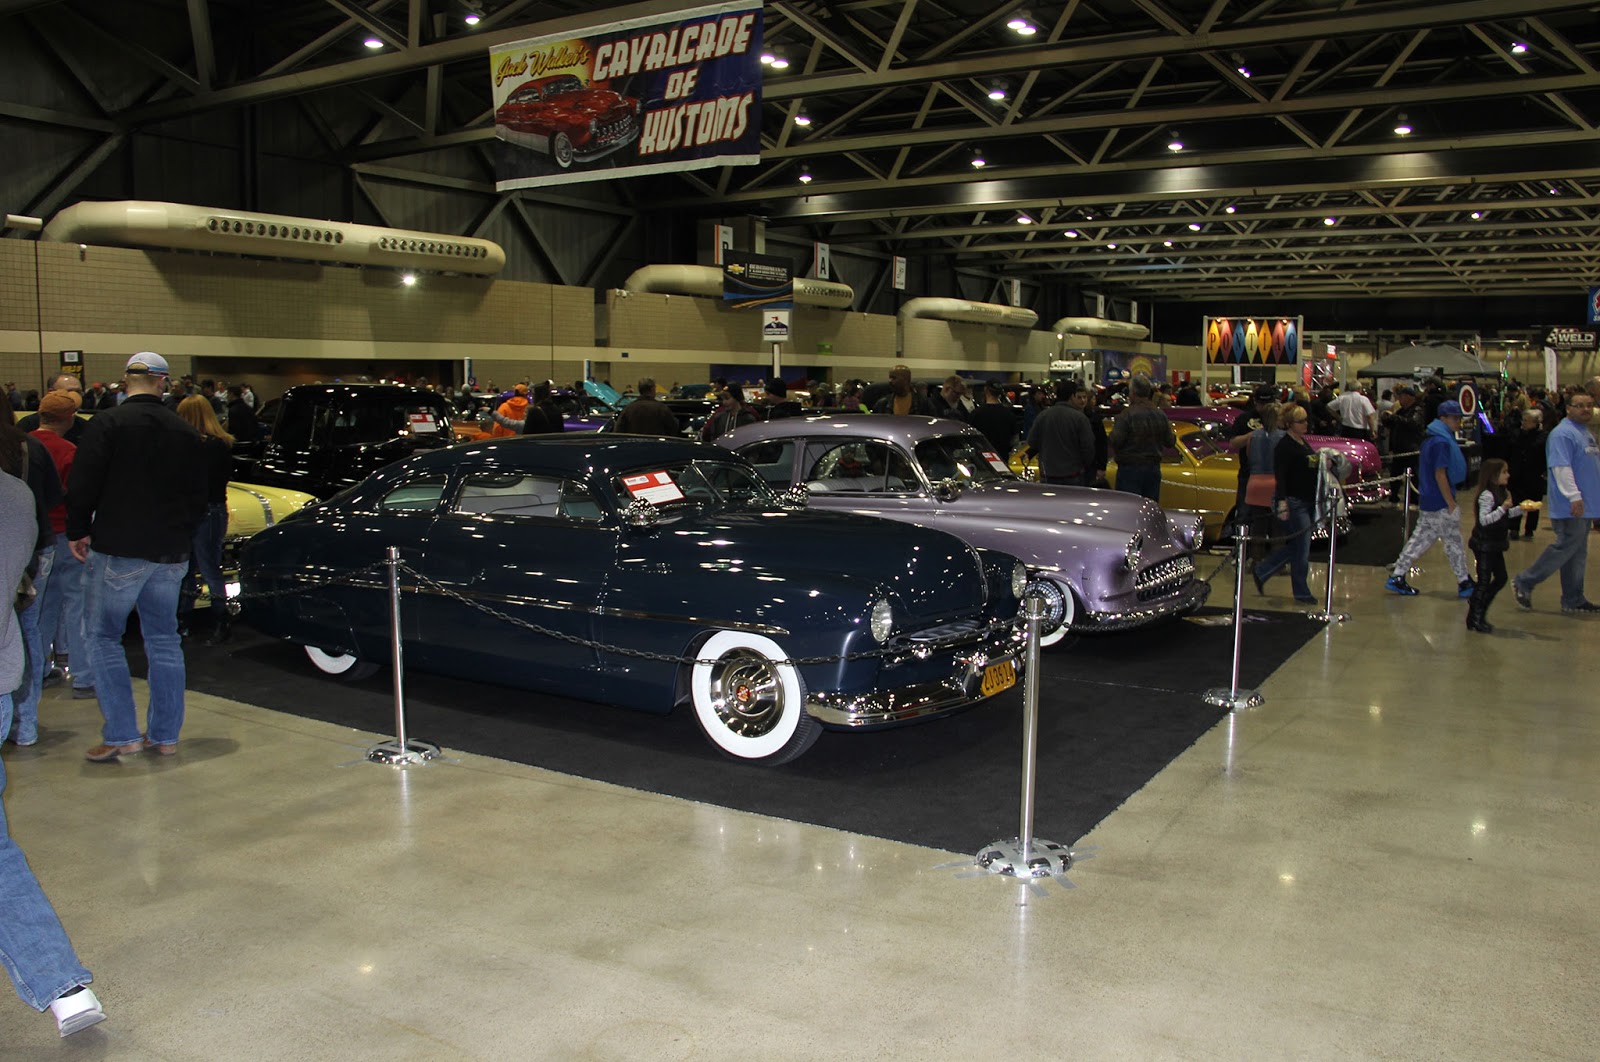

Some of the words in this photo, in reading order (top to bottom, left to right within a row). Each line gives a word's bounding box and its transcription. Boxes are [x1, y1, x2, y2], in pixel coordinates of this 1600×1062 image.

[593, 14, 755, 82] CAVALCADE
[496, 55, 529, 87] Jack
[528, 46, 592, 74] Walker's
[664, 67, 700, 100] OF
[639, 93, 754, 155] KUSTOMS
[820, 256, 827, 275] A
[1209, 332, 1295, 351] PONTIAC
[1558, 333, 1595, 342] WELD
